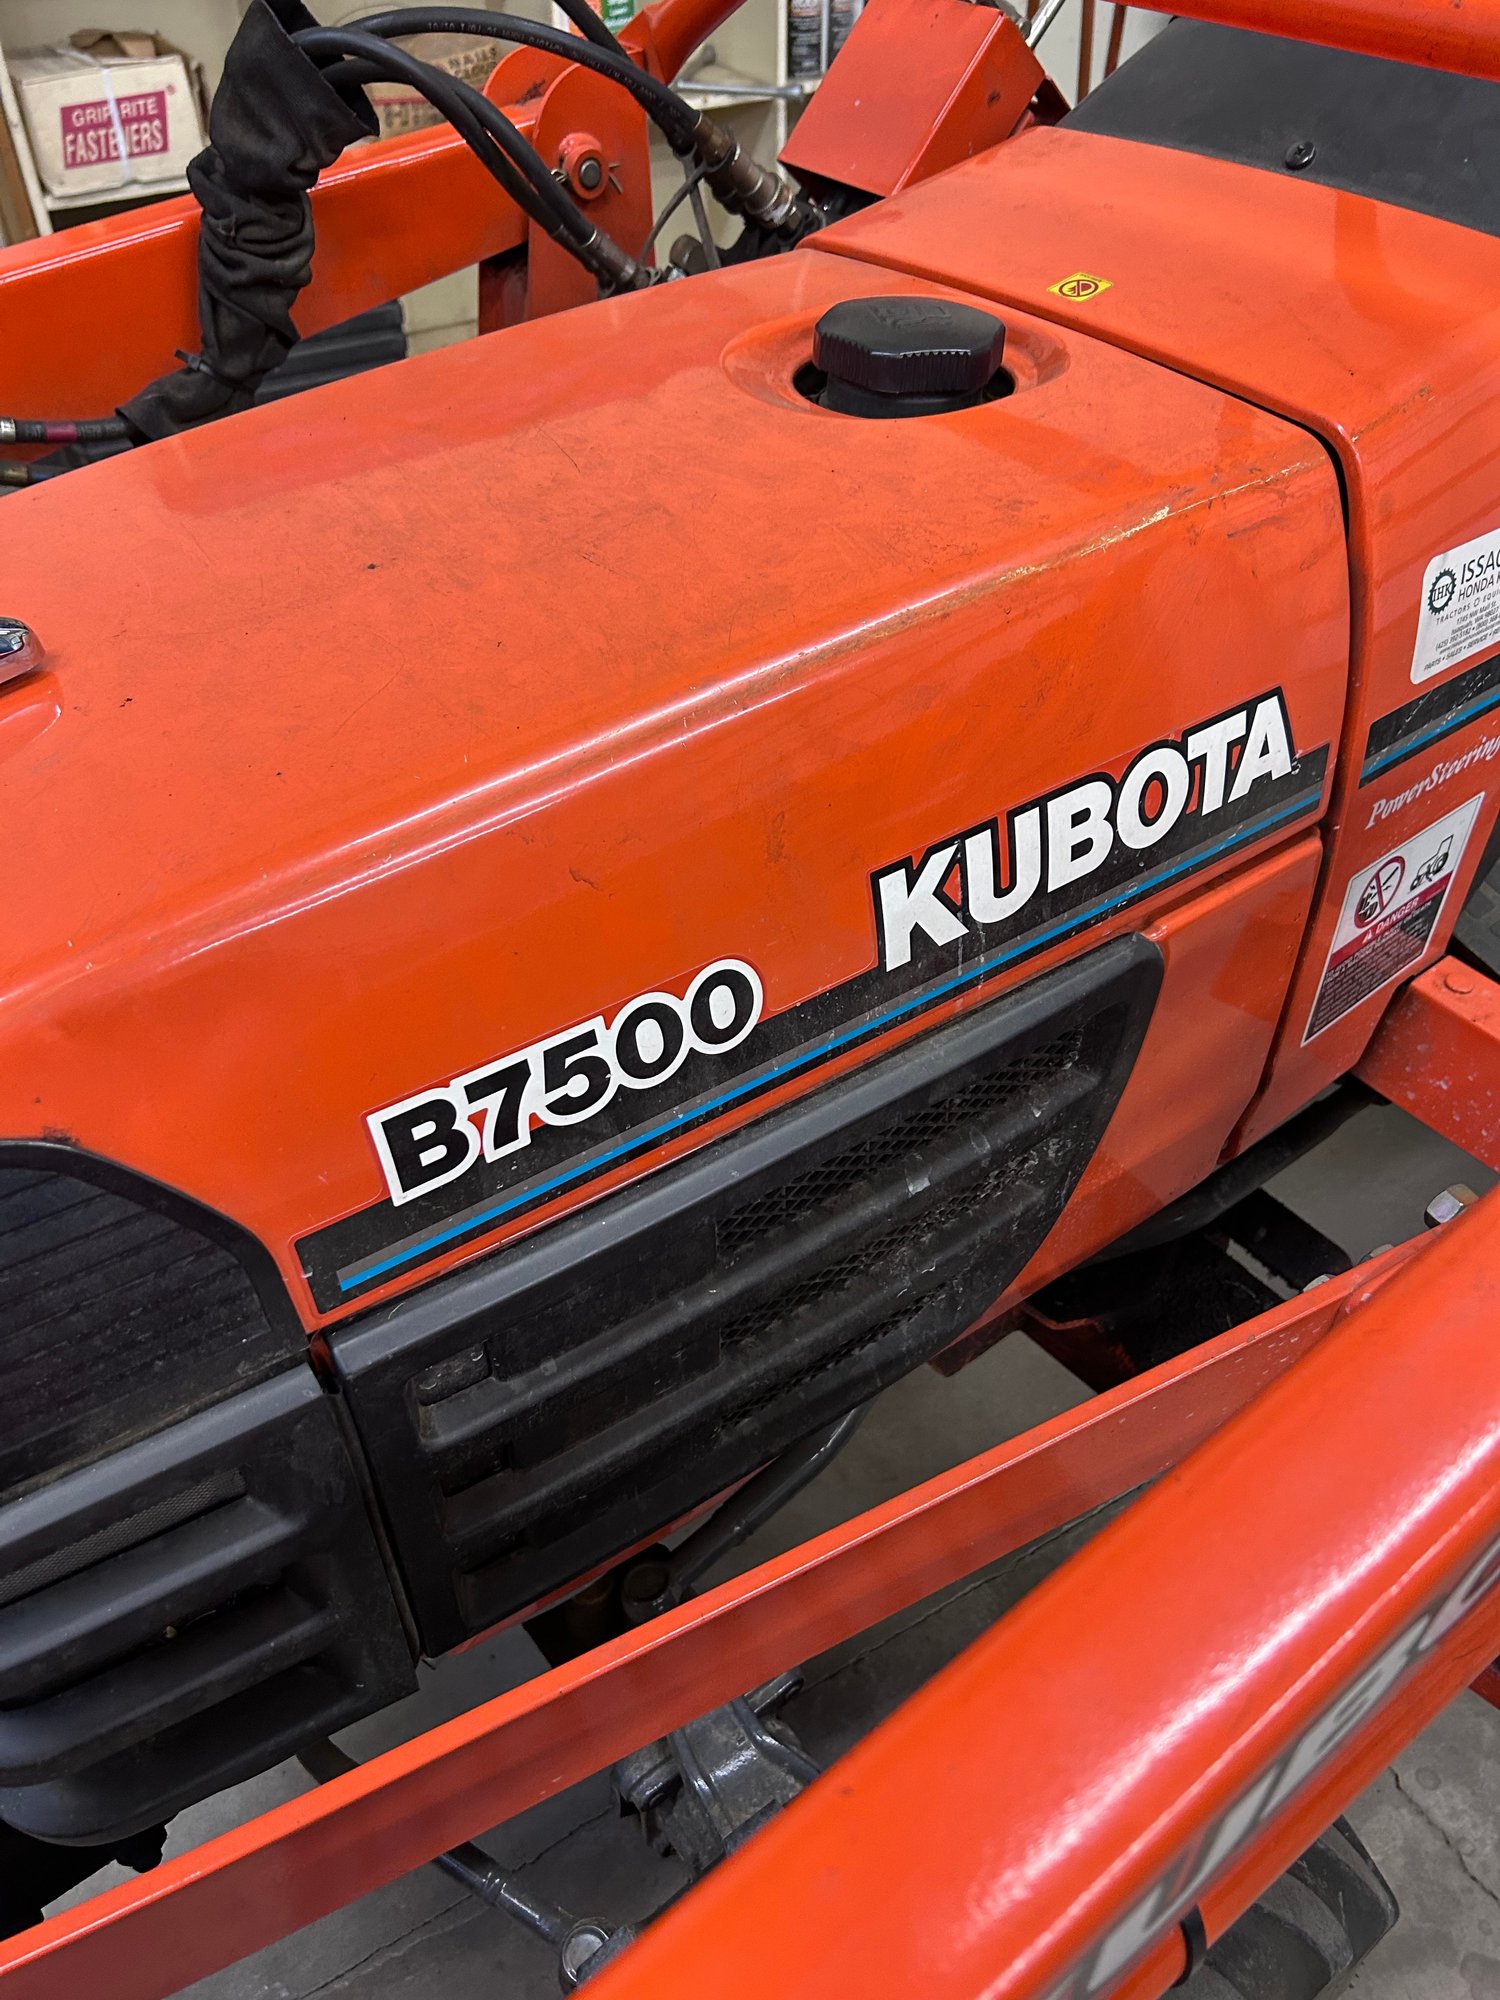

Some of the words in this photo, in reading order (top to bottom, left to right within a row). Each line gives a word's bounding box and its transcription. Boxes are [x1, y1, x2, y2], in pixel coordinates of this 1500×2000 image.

[120, 97, 159, 118] RITE
[1431, 582, 1454, 602] IHK
[1458, 573, 1494, 602] HONDA
[1436, 602, 1471, 625] TRACTORS
[877, 694, 1293, 973] KUBOTA
[1375, 896, 1420, 935] DANGER
[370, 962, 761, 1203] B7500
